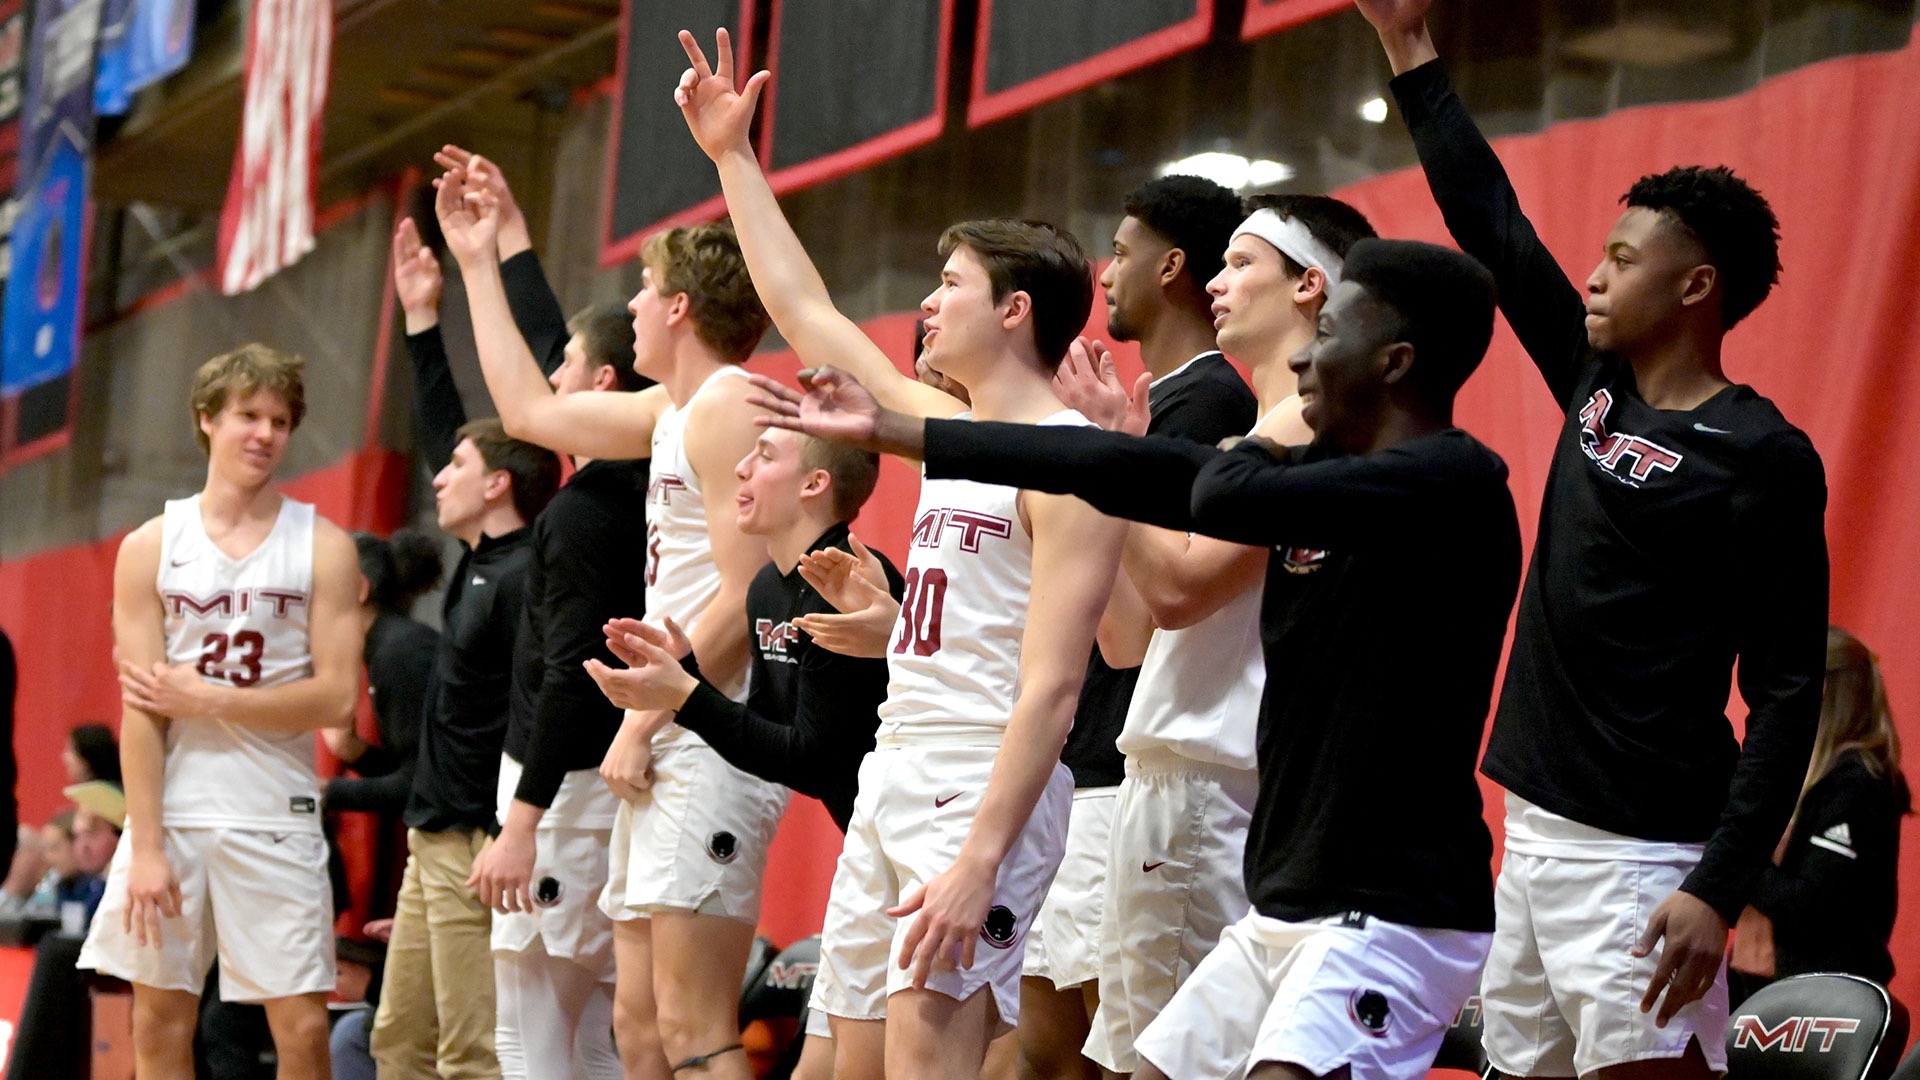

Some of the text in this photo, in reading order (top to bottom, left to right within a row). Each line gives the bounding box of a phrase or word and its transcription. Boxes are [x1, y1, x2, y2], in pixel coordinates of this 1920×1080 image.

[1578, 388, 1684, 482] MIT
[162, 588, 307, 619] MIT
[892, 566, 948, 658] 30
[196, 629, 265, 688] 23
[1733, 1014, 1861, 1052] MIT
